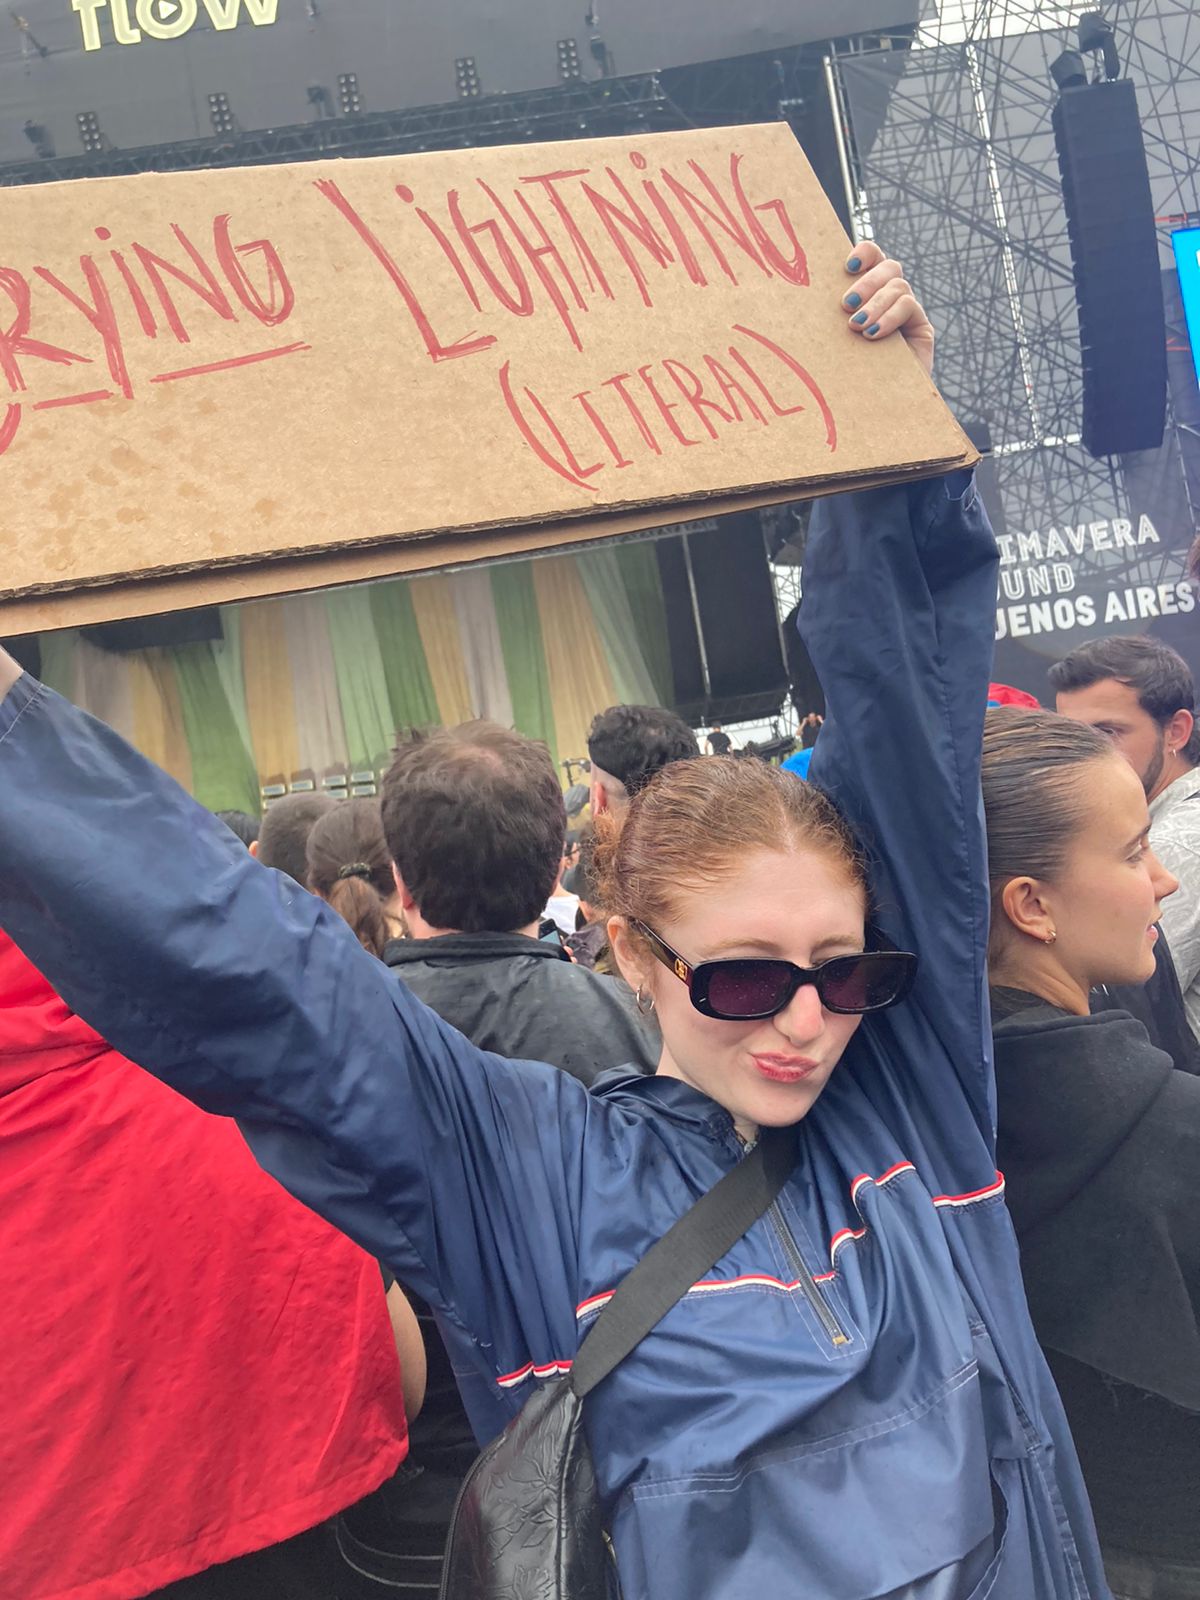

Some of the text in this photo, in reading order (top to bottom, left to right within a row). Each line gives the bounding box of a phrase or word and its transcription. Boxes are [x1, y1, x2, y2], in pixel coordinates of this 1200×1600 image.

[499, 323, 837, 491] (LITERAL)
[995, 513, 1160, 566] IMAVERA
[997, 562, 1075, 601] UND
[995, 581, 1195, 641] UENOS AIRES
